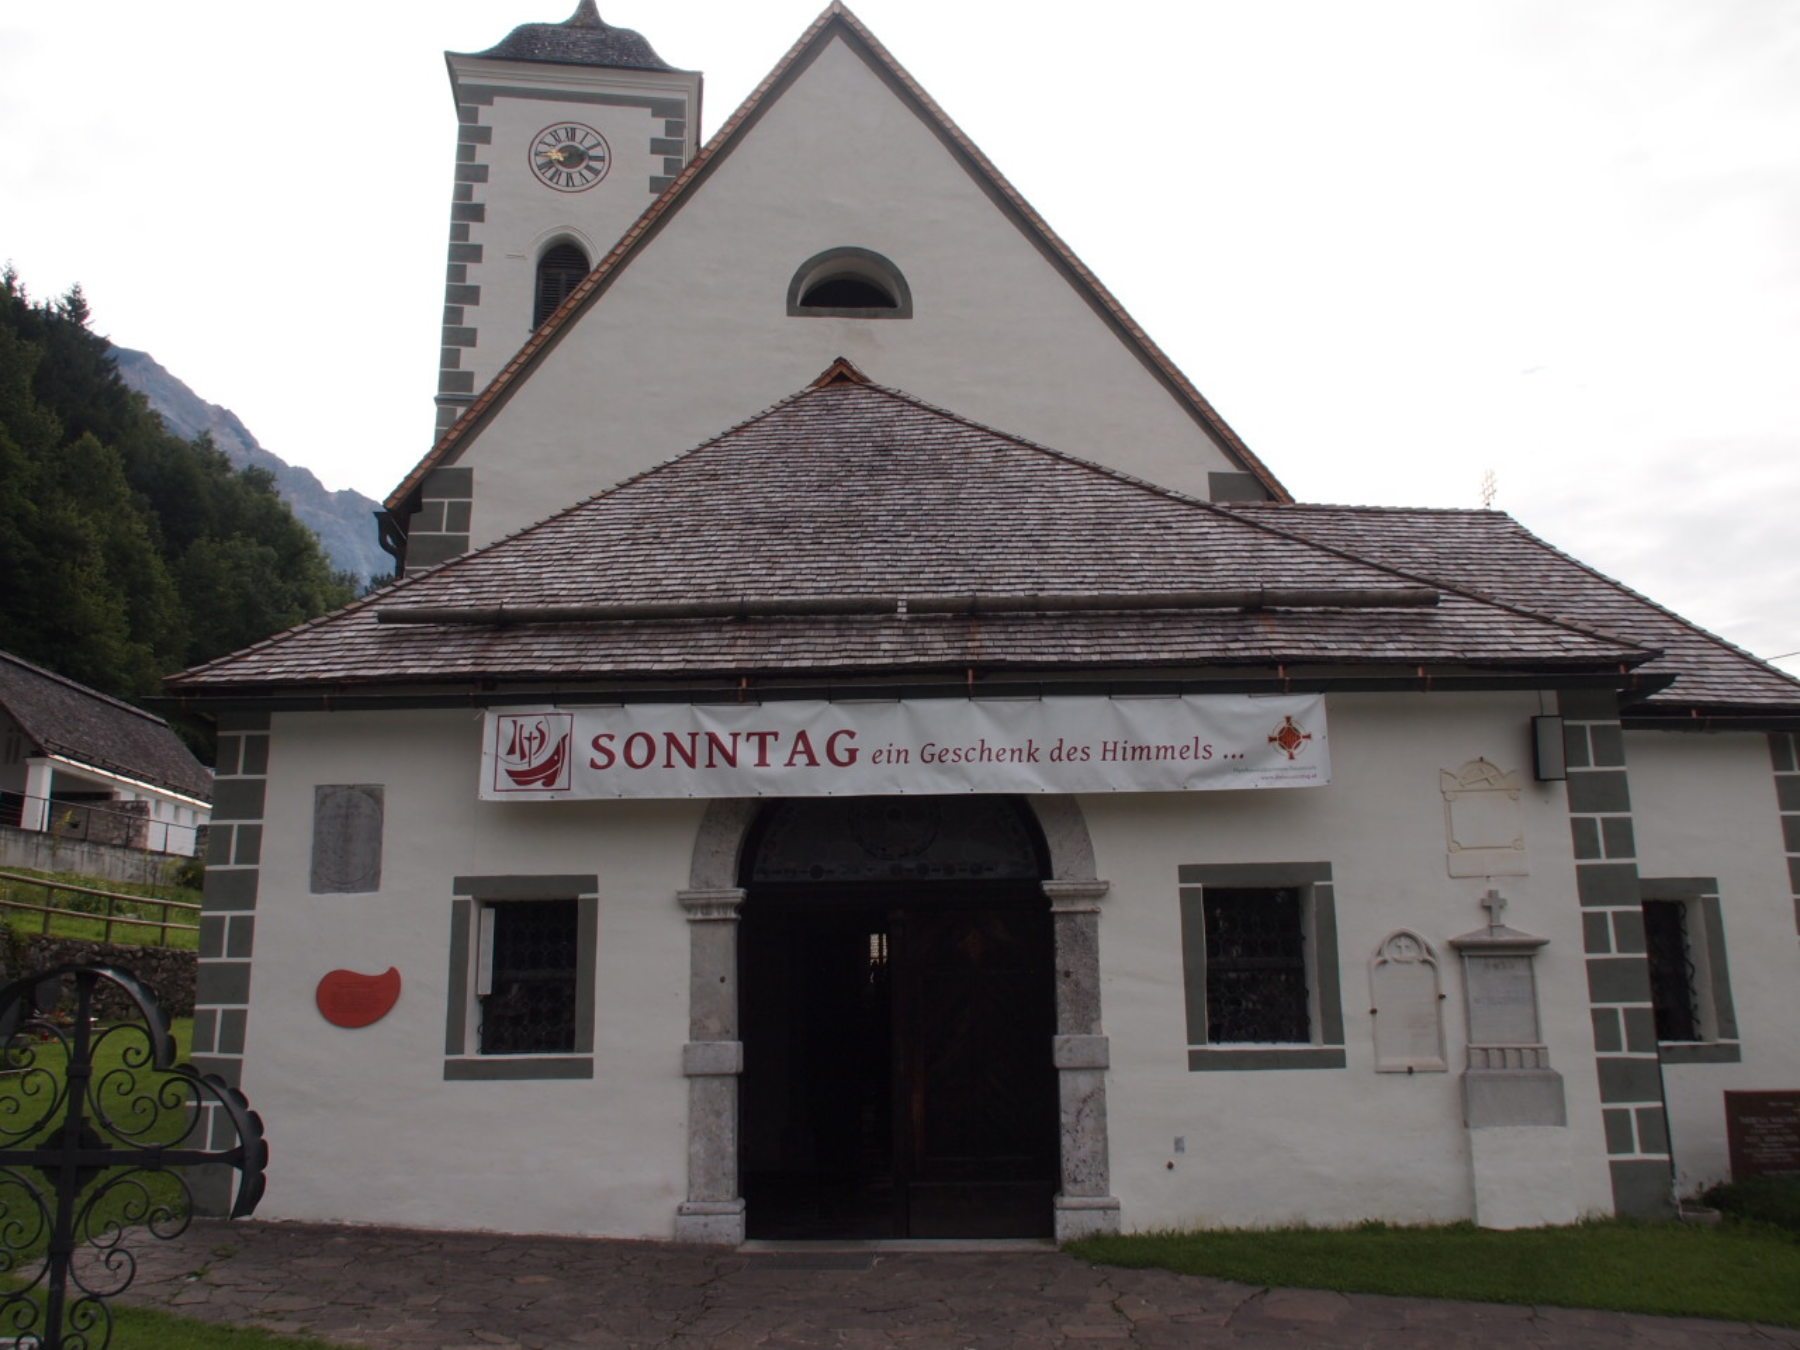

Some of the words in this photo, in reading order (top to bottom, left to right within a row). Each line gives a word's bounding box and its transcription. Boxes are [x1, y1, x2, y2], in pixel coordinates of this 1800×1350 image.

[588, 729, 861, 770] SONNTAG
[871, 746, 909, 765] ein
[920, 738, 1040, 764] Geschenk
[1050, 736, 1092, 763] des
[1100, 735, 1215, 762] Himmels
